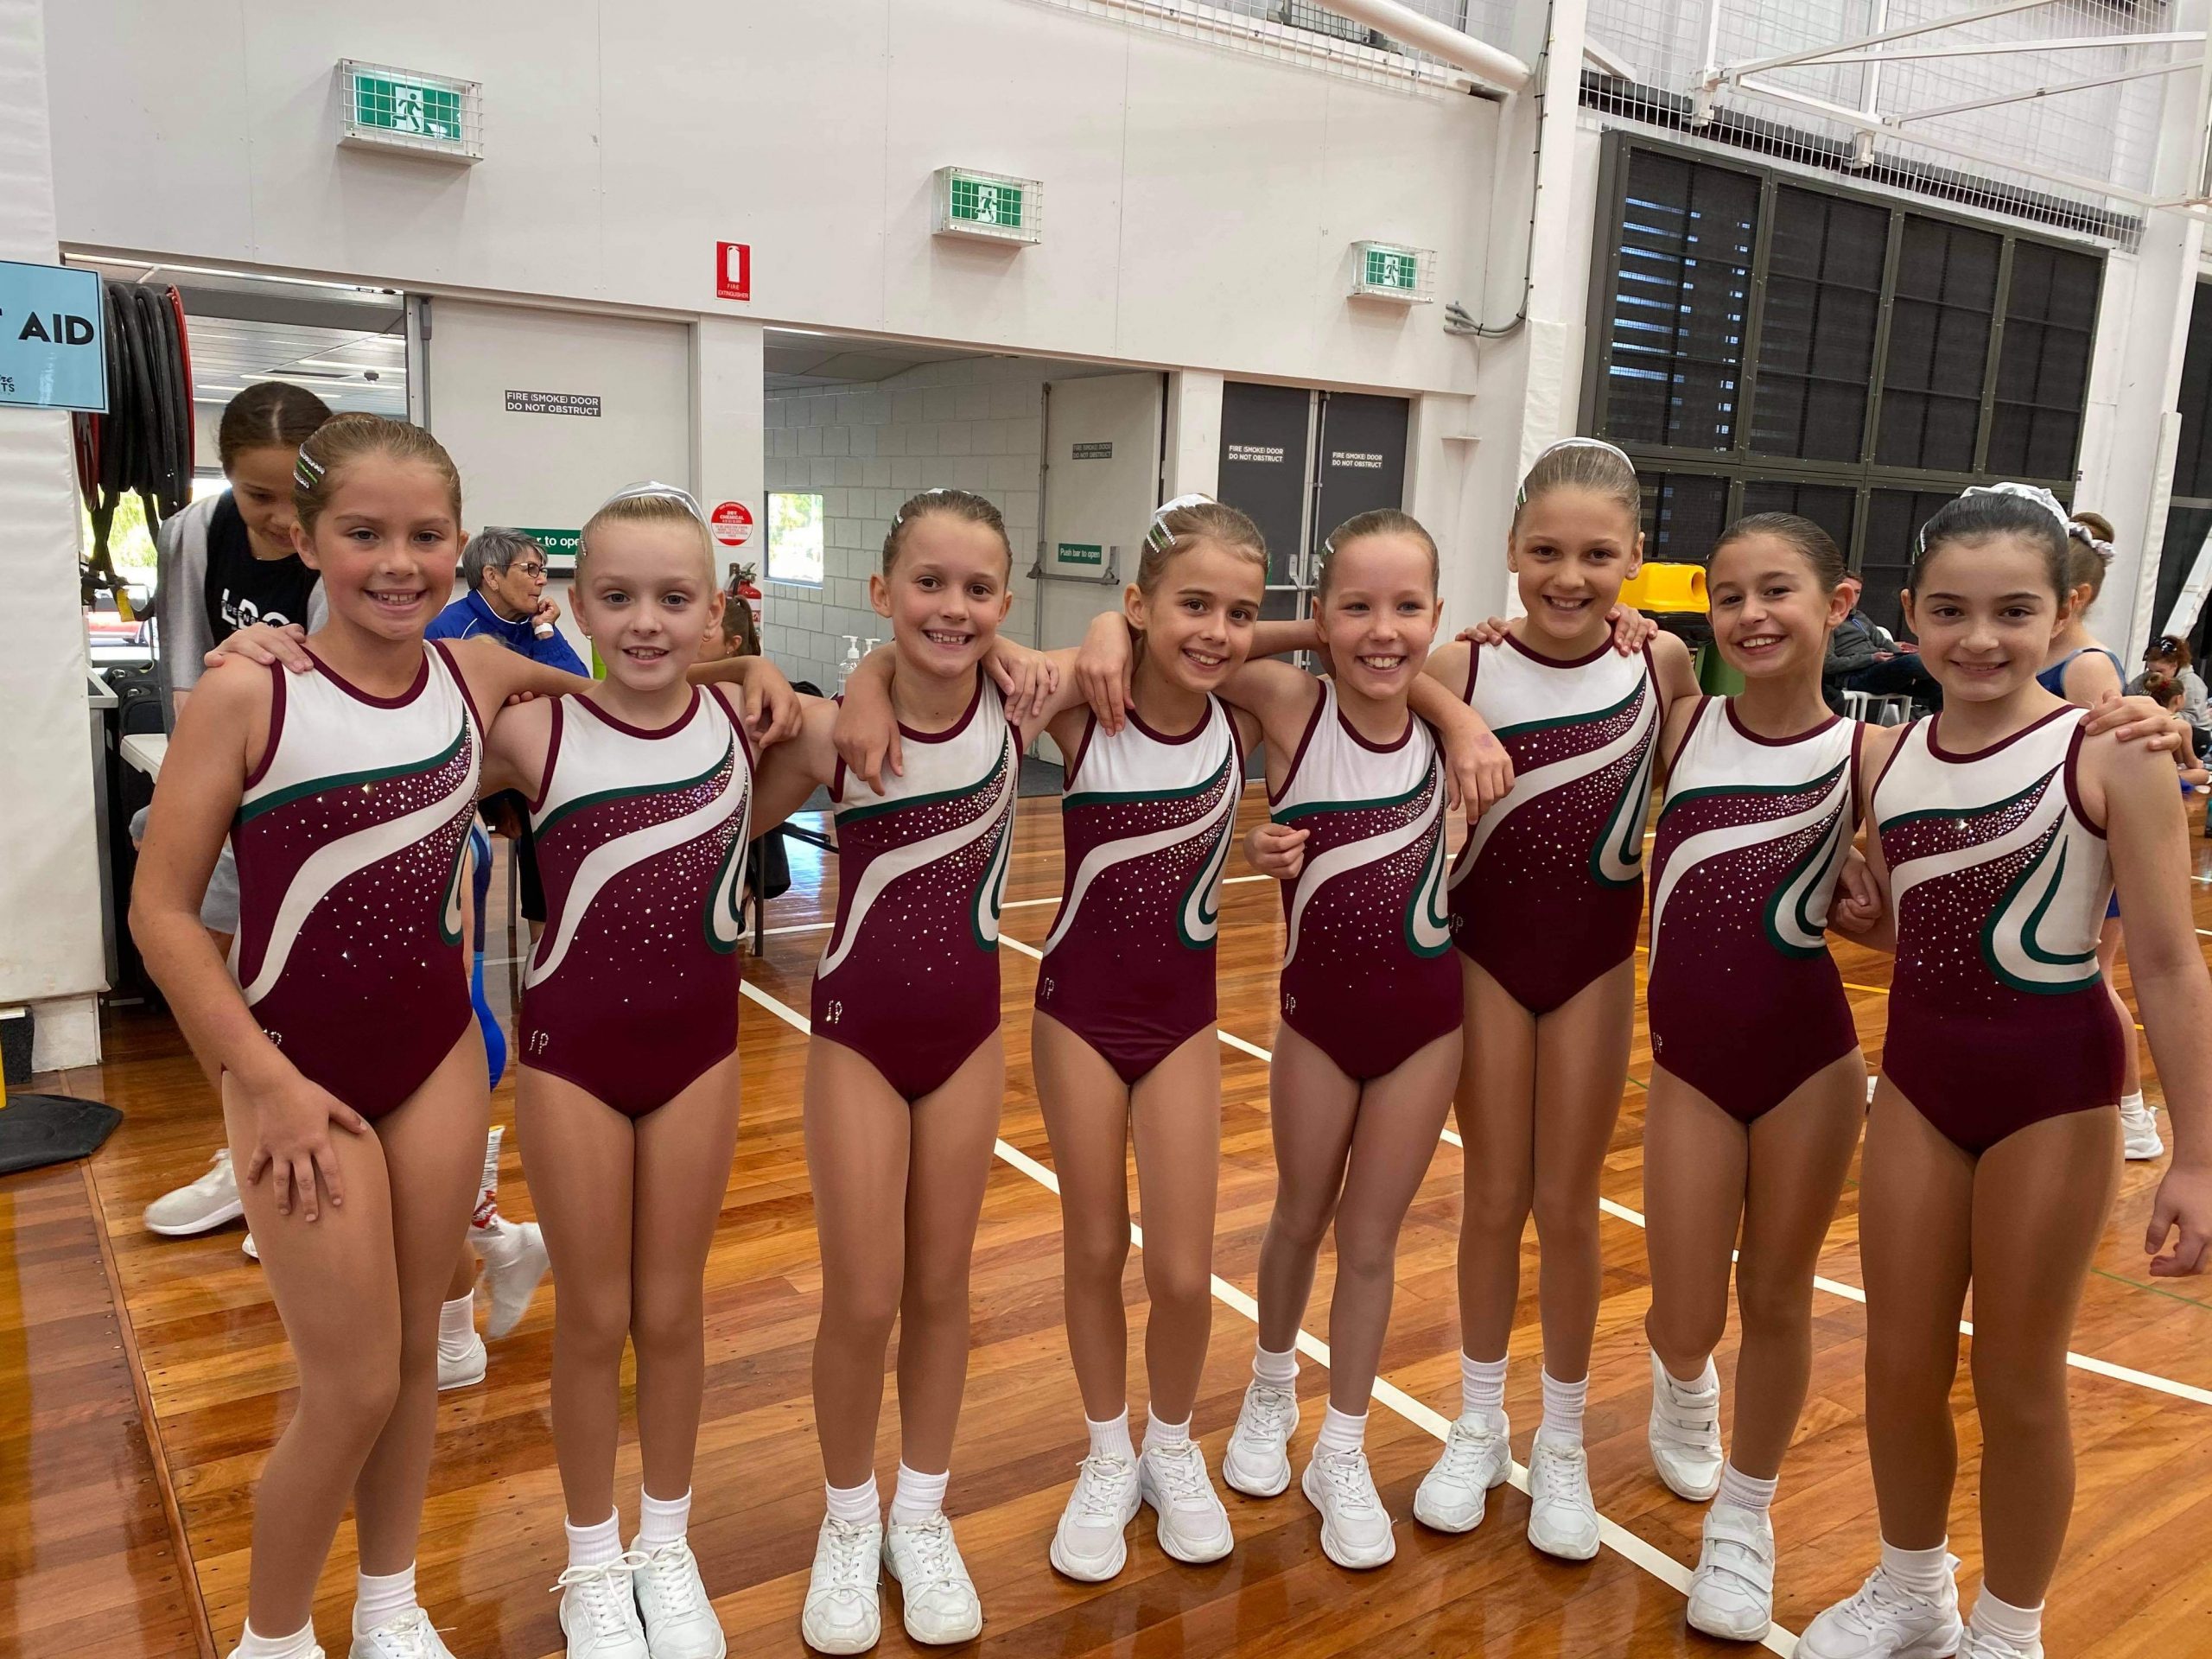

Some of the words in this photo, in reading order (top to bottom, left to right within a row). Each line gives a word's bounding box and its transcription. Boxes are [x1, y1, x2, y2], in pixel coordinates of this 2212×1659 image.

[18, 311, 94, 345] AID
[506, 391, 528, 401] FIRE
[531, 393, 568, 404] (SMOKE)
[570, 396, 599, 406] DOOR
[507, 402, 522, 410] DO
[524, 403, 546, 412] NOT
[548, 404, 599, 416] OBSTRUCT
[544, 536, 557, 546] to
[560, 537, 580, 549] ope
[1060, 548, 1071, 556] Push
